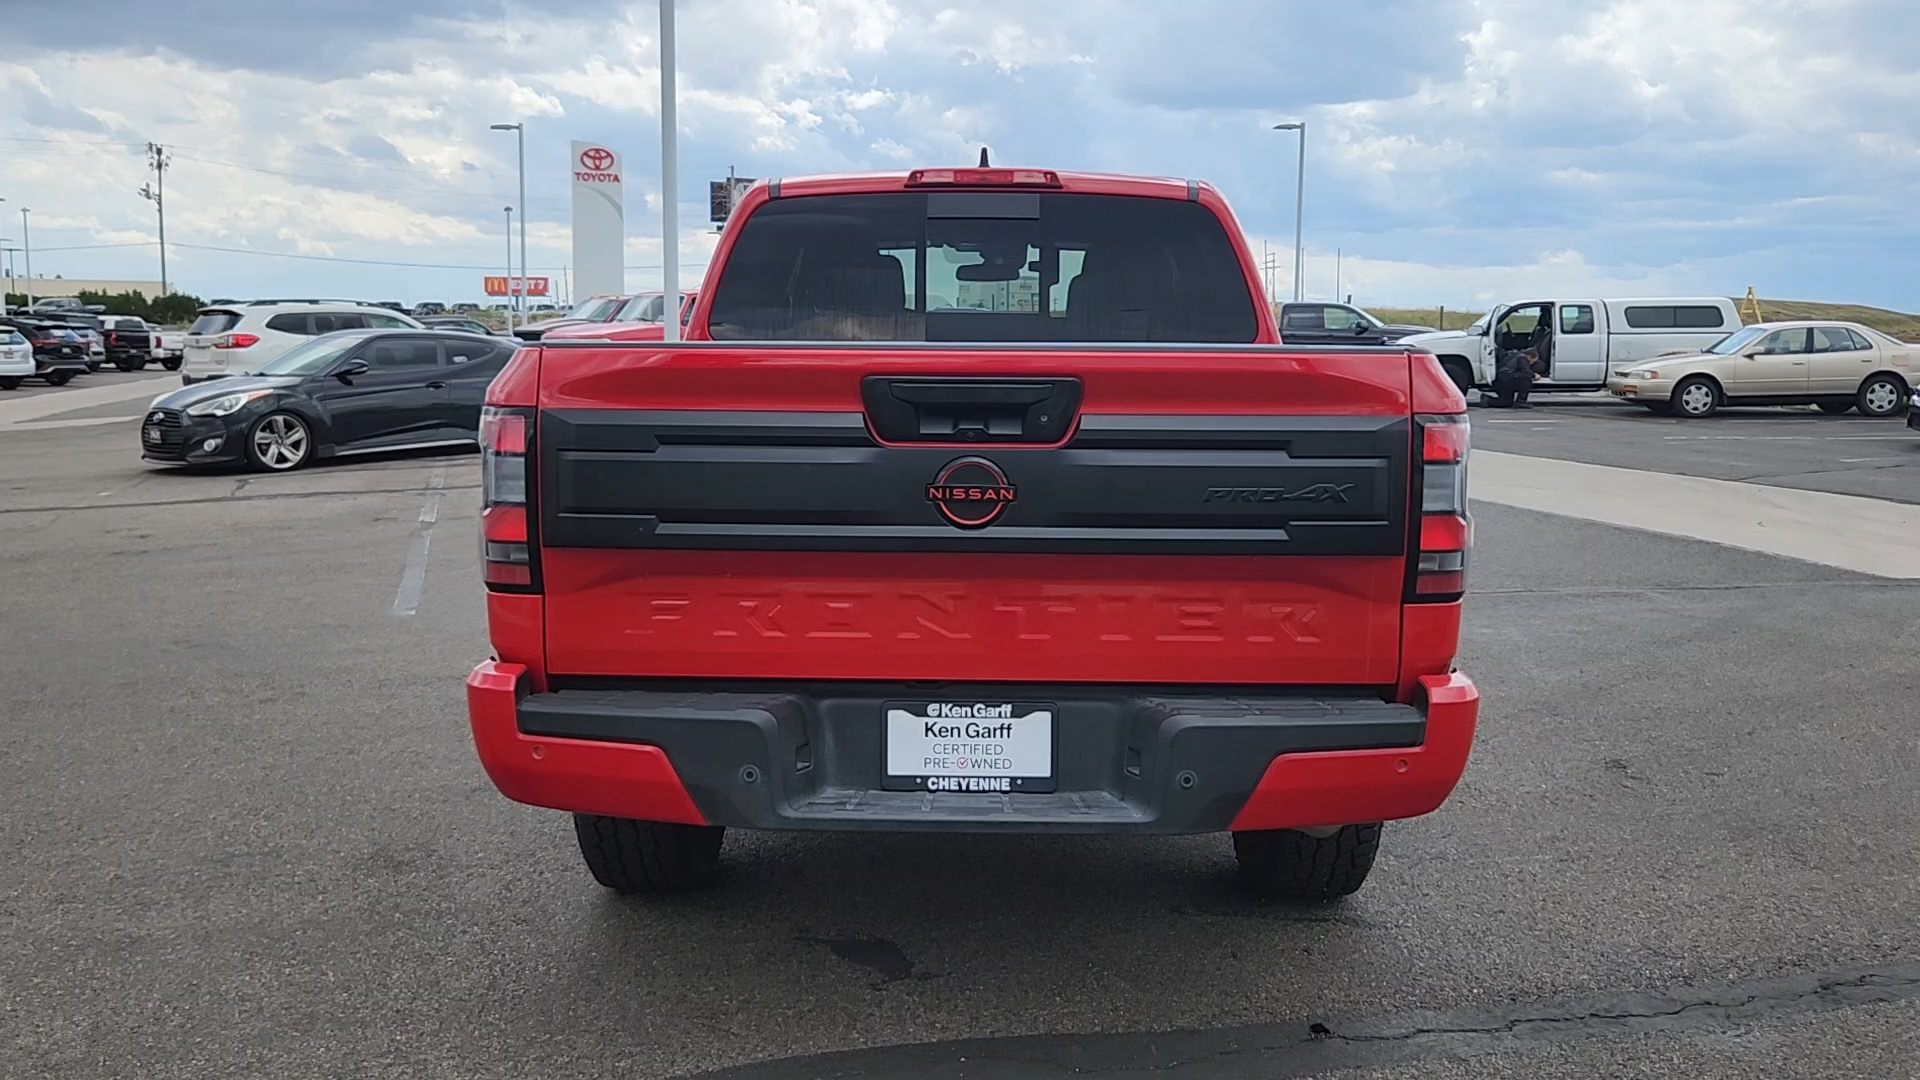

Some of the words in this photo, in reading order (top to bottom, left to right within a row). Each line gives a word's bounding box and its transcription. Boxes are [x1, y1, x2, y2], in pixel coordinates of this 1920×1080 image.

[574, 171, 621, 184] TOYOTA
[511, 279, 537, 290] EXT
[929, 487, 1014, 500] NISSAN
[1201, 483, 1355, 503] PRO-4X
[941, 703, 972, 718] Ken
[972, 703, 1013, 719] Garff
[924, 721, 961, 738] Ken
[965, 722, 1013, 739] Garff
[932, 743, 1004, 755] CERTIFIED
[923, 756, 1013, 770] PRE-OWNED
[927, 776, 1012, 791] CHEYENNE
